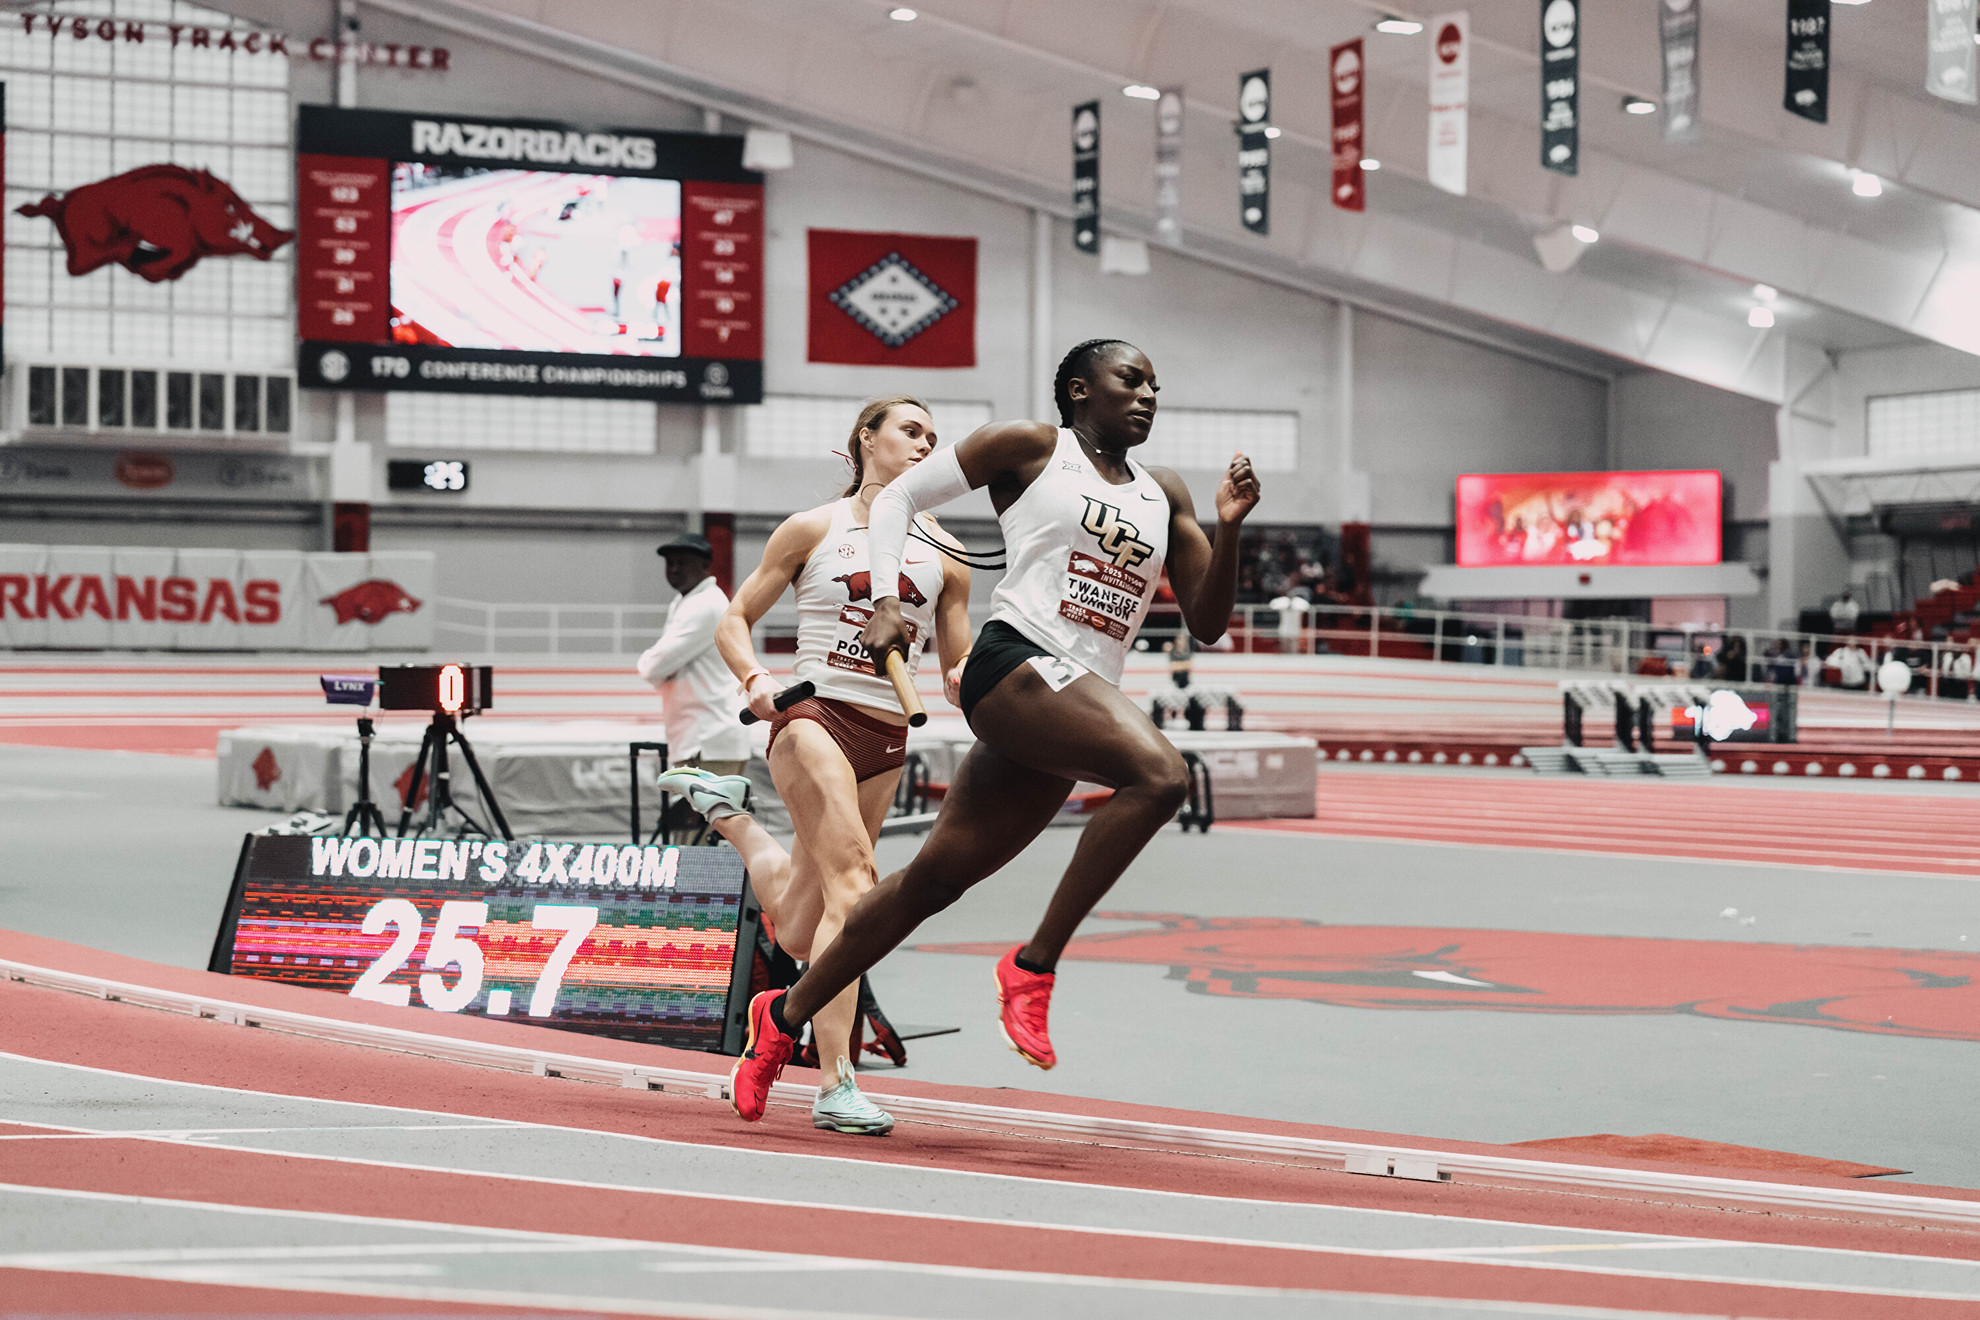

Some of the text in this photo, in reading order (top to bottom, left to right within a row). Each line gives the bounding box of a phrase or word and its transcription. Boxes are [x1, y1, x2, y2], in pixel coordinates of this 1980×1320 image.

[22, 13, 144, 43] TYSON
[169, 25, 289, 56] TRACK
[412, 120, 656, 170] RAZORBACKS
[420, 359, 540, 384] CONFERENCE
[541, 363, 687, 389] CHAMPIONSHIPS
[1080, 494, 1155, 569] UCF
[1103, 565, 1122, 578] 2025
[1068, 577, 1139, 613] TWANEISE
[1069, 591, 1132, 621] JOHNSON
[836, 640, 871, 660] POD
[439, 664, 464, 711] 0
[311, 836, 679, 888] WOMEN'S 4X400M
[349, 898, 599, 1017] 25.7
